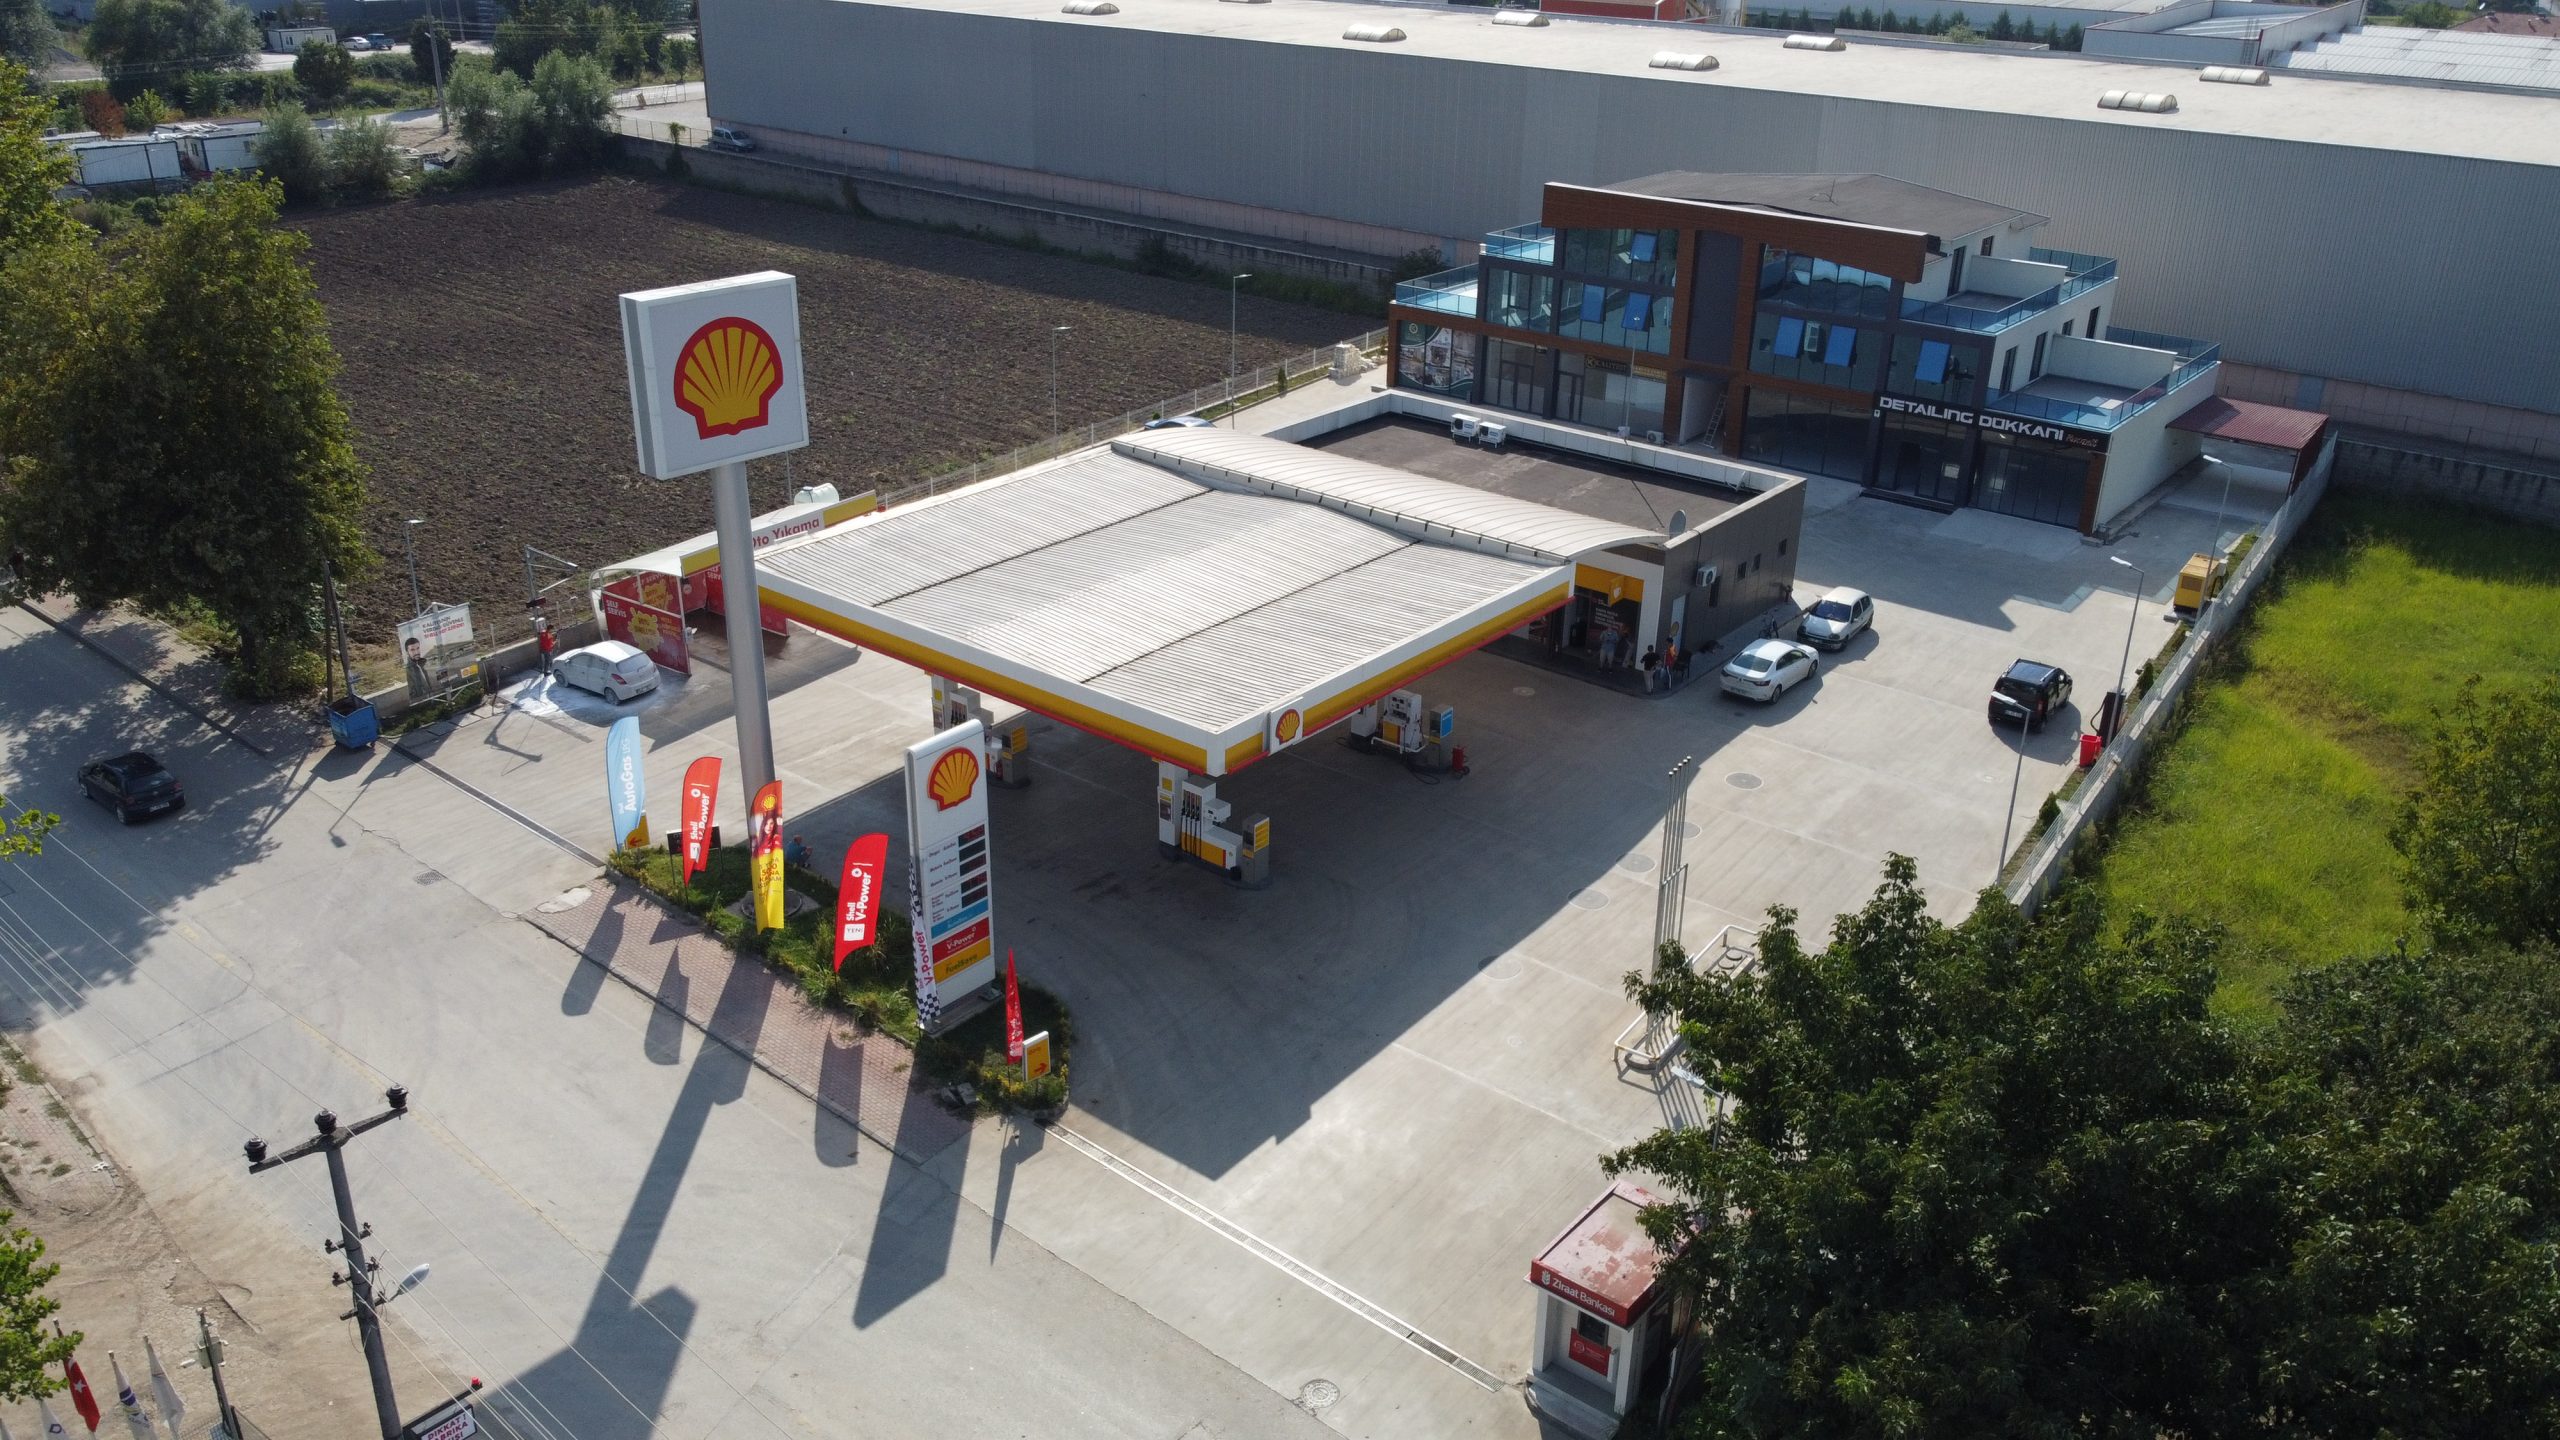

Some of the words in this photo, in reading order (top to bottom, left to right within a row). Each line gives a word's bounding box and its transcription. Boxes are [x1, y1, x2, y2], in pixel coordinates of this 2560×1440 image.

[1879, 396, 1974, 425] DETAILING
[620, 755, 637, 812] AutoGas
[689, 821, 699, 840] Shell
[846, 902, 856, 921] Shell
[855, 872, 872, 921] V-Power
[915, 930, 934, 986] V-Power
